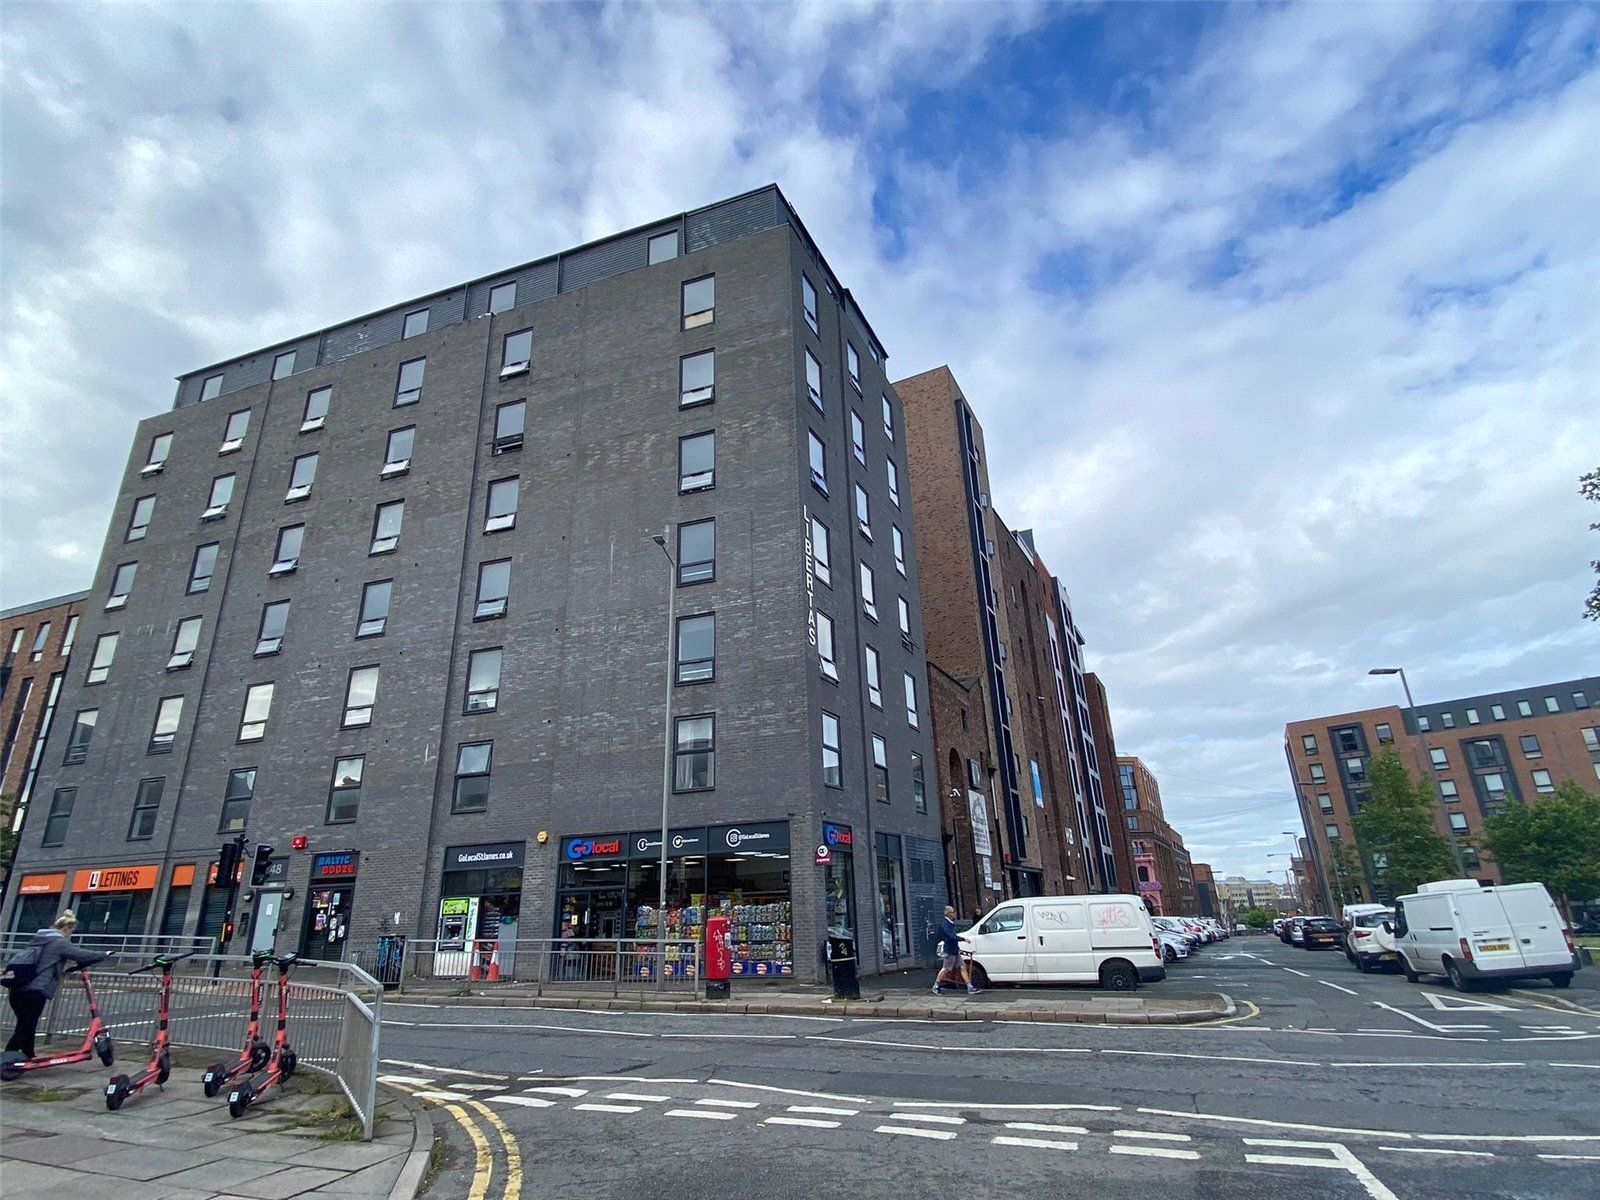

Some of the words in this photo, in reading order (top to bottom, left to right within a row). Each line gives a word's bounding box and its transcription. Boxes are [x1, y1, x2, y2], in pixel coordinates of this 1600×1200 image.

[803, 504, 816, 646] LIBERTAS
[592, 840, 619, 854] local
[318, 855, 350, 866] BALTIC
[269, 863, 282, 875] 48
[322, 864, 356, 875] BOOZE
[99, 870, 139, 888] LETTINGS
